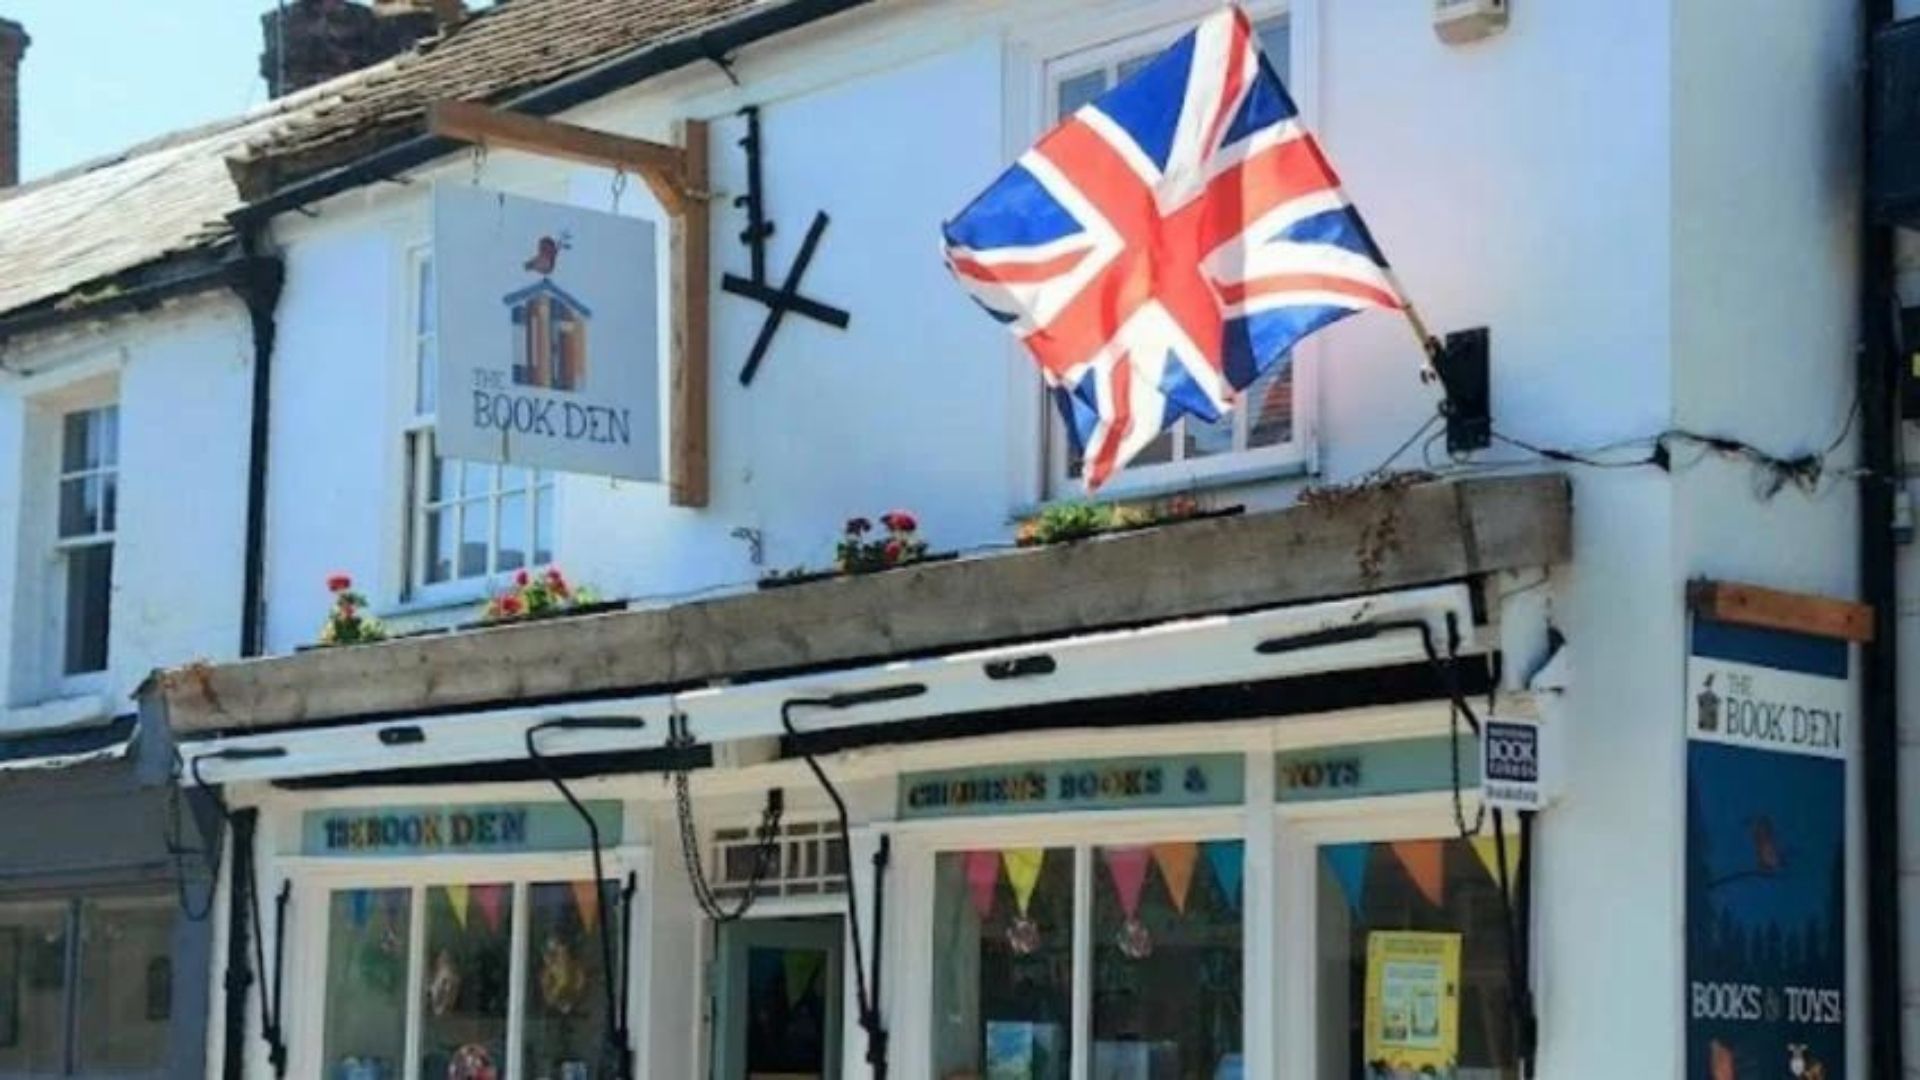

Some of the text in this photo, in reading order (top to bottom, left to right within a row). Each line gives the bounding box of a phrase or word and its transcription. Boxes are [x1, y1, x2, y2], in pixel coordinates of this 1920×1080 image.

[473, 368, 506, 390] THE
[473, 391, 631, 445] BOOK DEN
[1727, 673, 1753, 695] THE
[1726, 697, 1842, 750] BOOK DEN
[1059, 767, 1164, 800] BOOKS
[1184, 765, 1207, 794] &
[1281, 757, 1362, 791] TOYS
[366, 812, 443, 849] BOOK
[450, 806, 527, 847] DEN
[1691, 981, 1762, 1020] BOOKS
